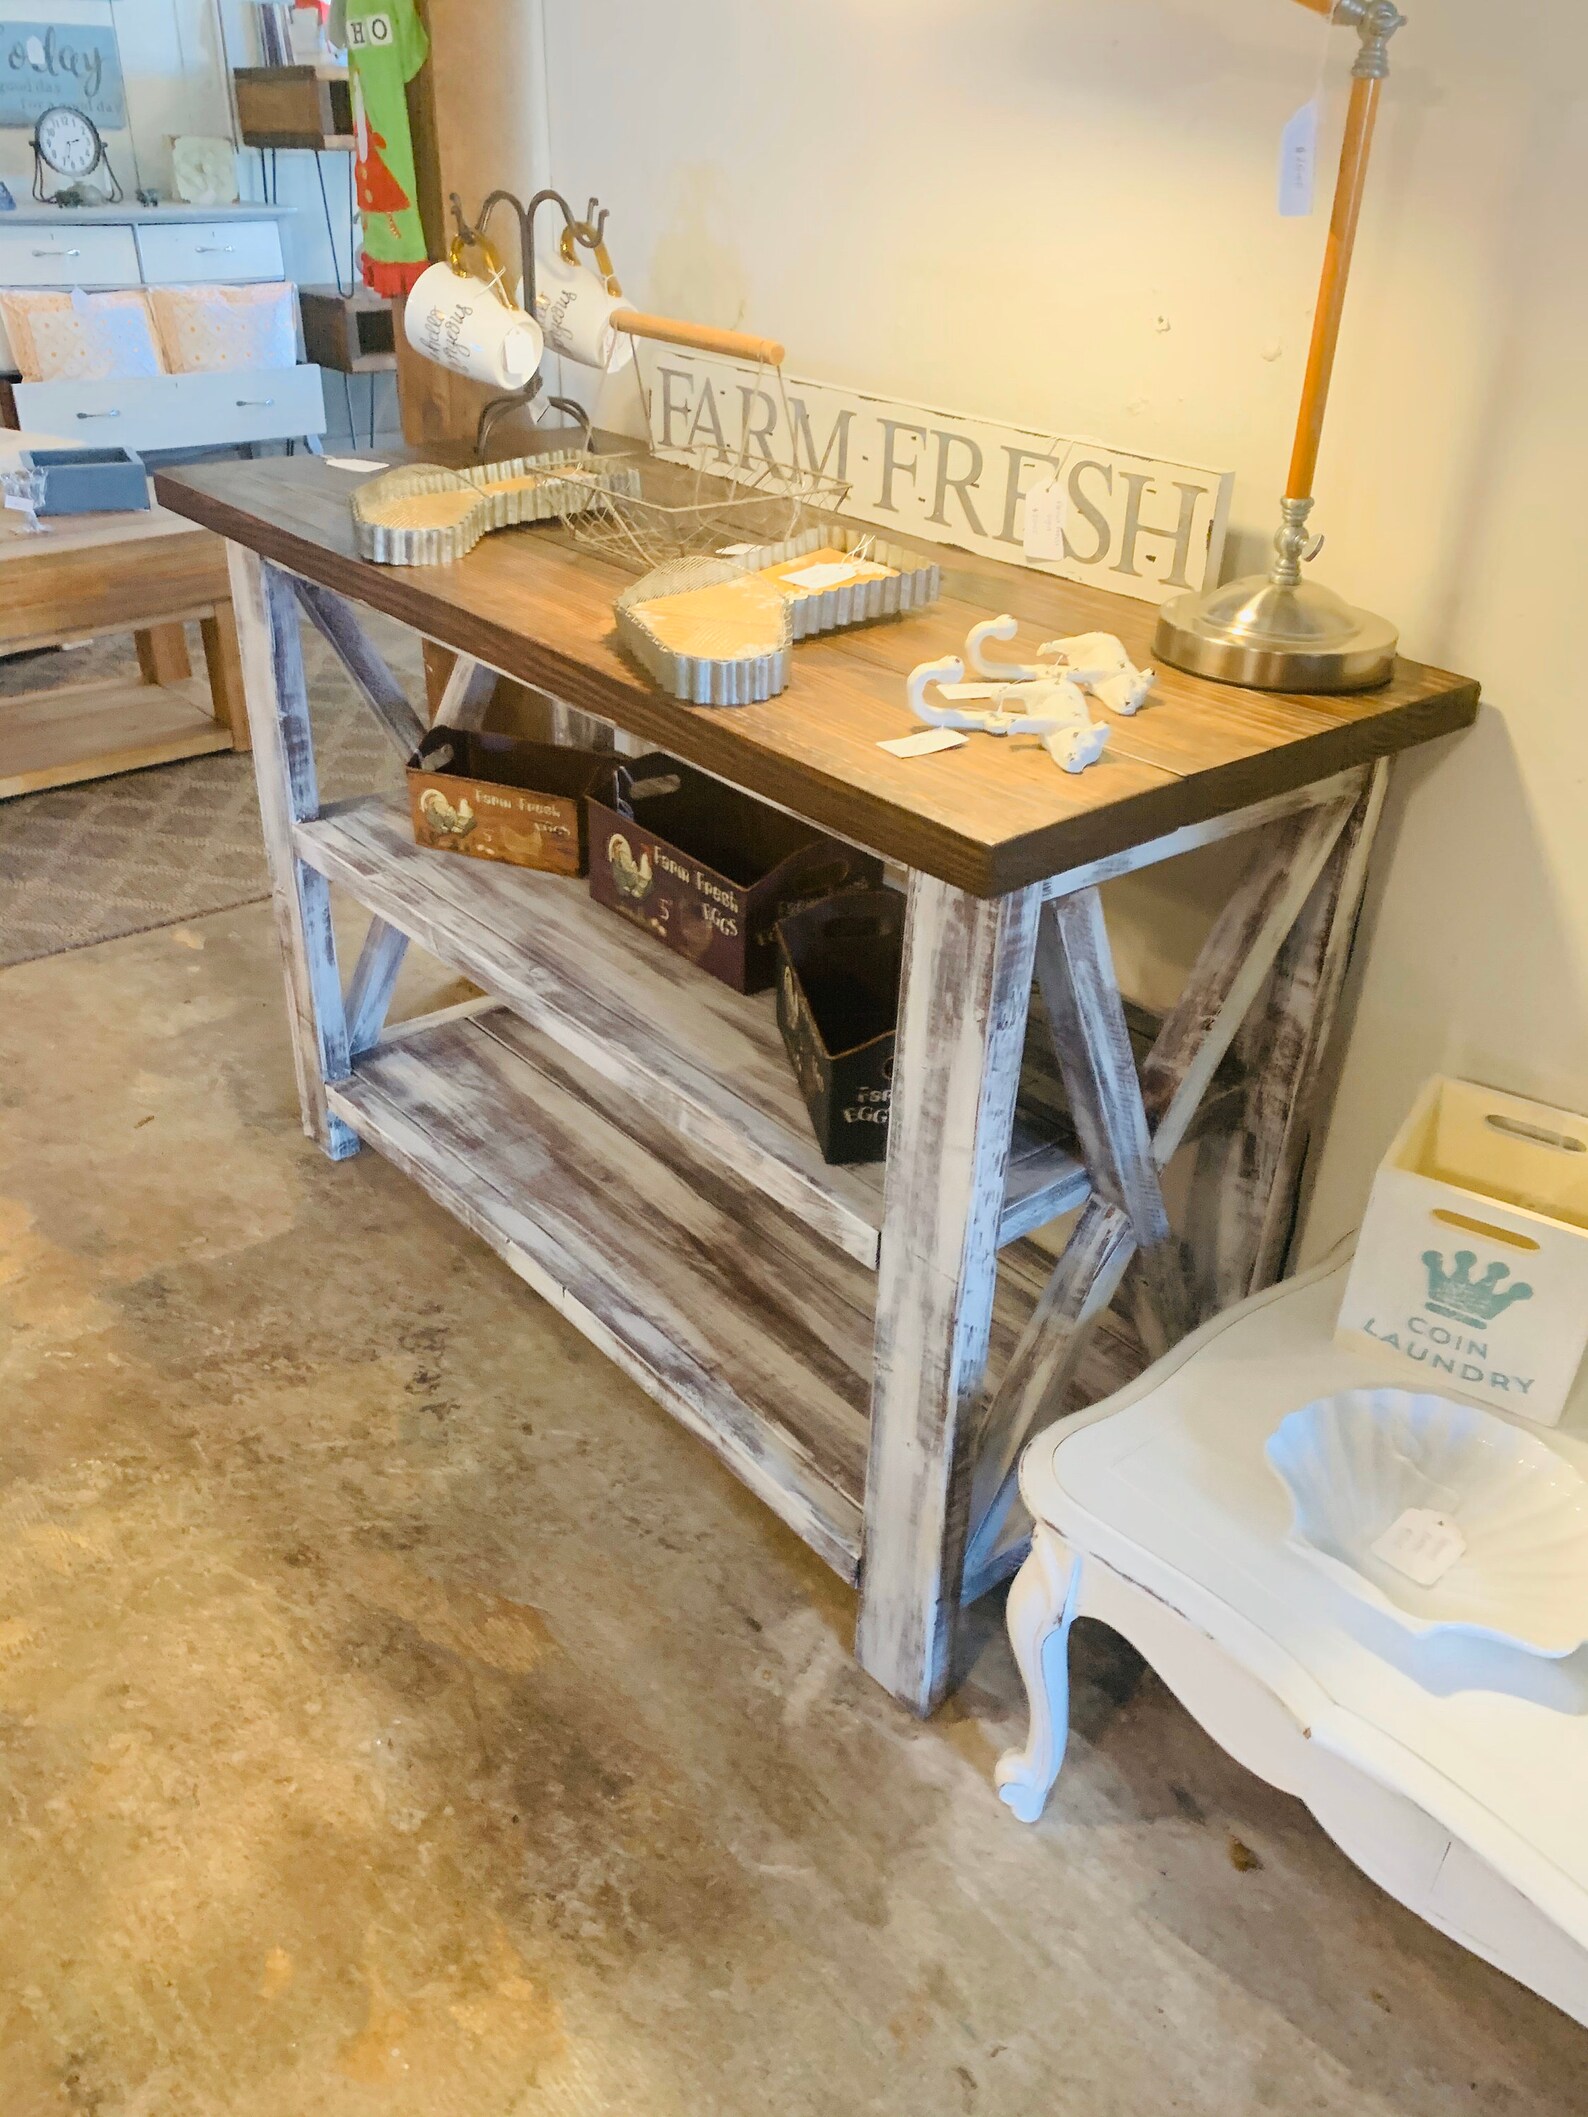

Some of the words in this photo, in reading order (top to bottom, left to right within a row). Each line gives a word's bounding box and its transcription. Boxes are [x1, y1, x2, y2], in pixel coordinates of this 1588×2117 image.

[0, 25, 102, 98] oday
[656, 365, 858, 502] FARM
[842, 1105, 890, 1124] EGG
[857, 1086, 893, 1103] Far
[1363, 1317, 1536, 1394] LAUNDRY
[1407, 1316, 1488, 1361] COIN
